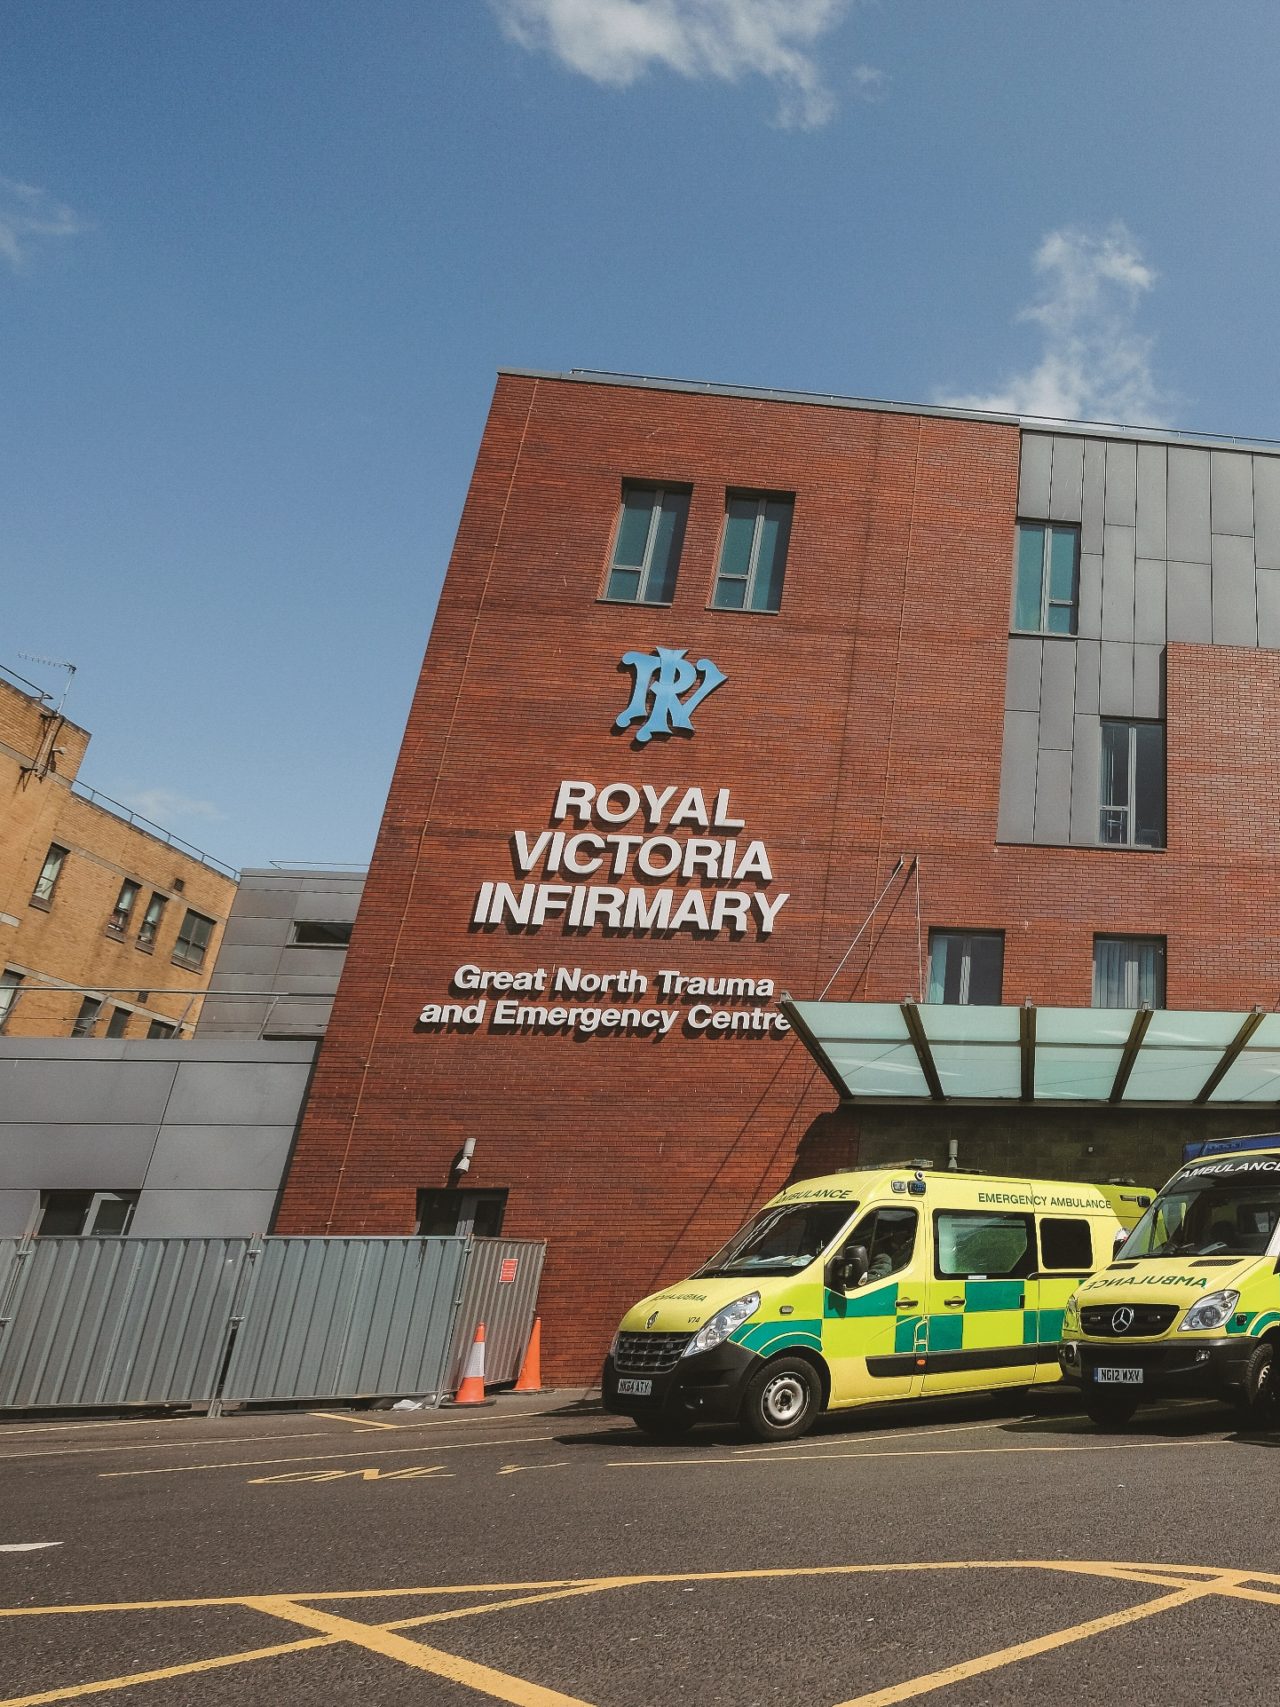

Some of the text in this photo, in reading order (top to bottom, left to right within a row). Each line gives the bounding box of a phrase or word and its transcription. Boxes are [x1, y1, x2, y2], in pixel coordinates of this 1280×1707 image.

[553, 780, 746, 829] ROYAL
[513, 830, 774, 881] VICTORIA
[473, 881, 791, 934] INFIRMARY
[453, 964, 775, 997] Great North Trauma
[419, 999, 792, 1034] and Emergency Centre
[978, 1192, 1112, 1209] EMERGENCY AMBULANCE
